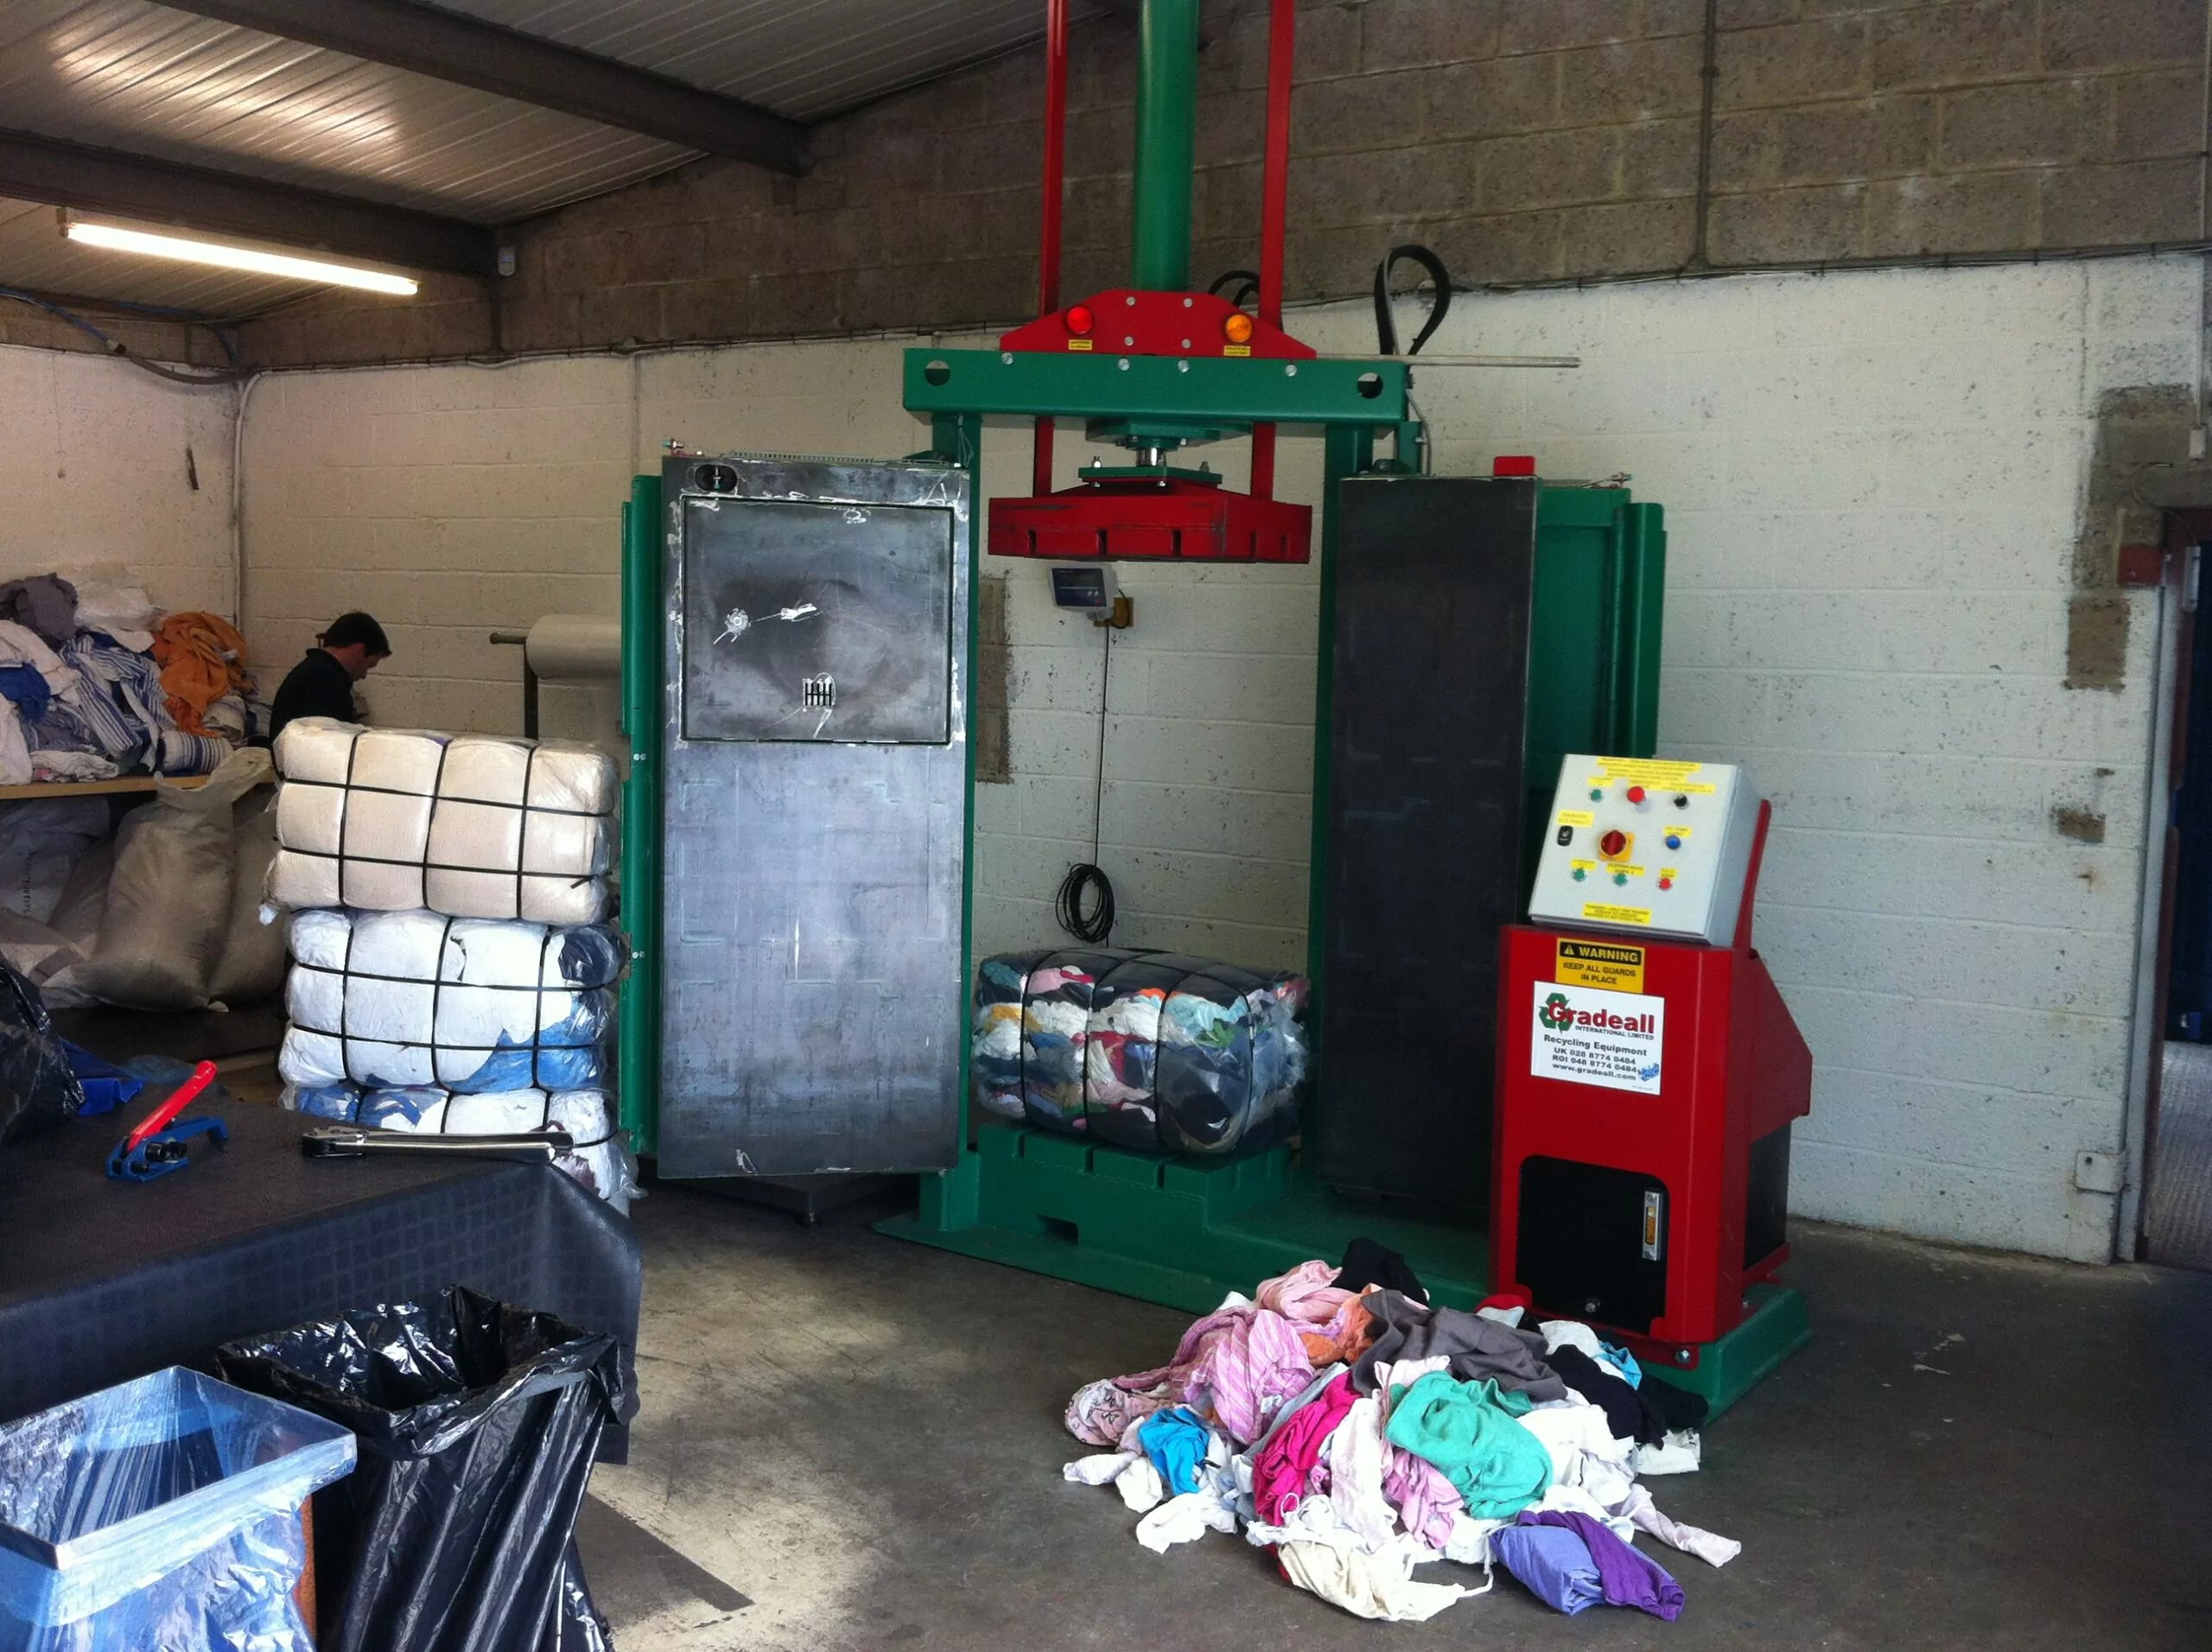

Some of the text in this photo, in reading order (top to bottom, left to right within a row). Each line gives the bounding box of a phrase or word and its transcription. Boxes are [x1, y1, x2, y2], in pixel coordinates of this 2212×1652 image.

[1579, 946, 1639, 963] WARNING
[1563, 962, 1637, 977] KEEP ALL GUARDS
[1591, 975, 1618, 985] PLACE
[1548, 1002, 1655, 1033] Gradeall
[1575, 1026, 1626, 1037] INTERNATIONAL
[1543, 1034, 1647, 1057] Recycling Equipment
[1552, 1054, 1637, 1074] ROI 048 8774 0484
[1569, 1049, 1586, 1058] 028
[1588, 1052, 1611, 1062] 8774
[1613, 1055, 1636, 1065] 0484
[1552, 1064, 1637, 1081] www.gradeall.com
